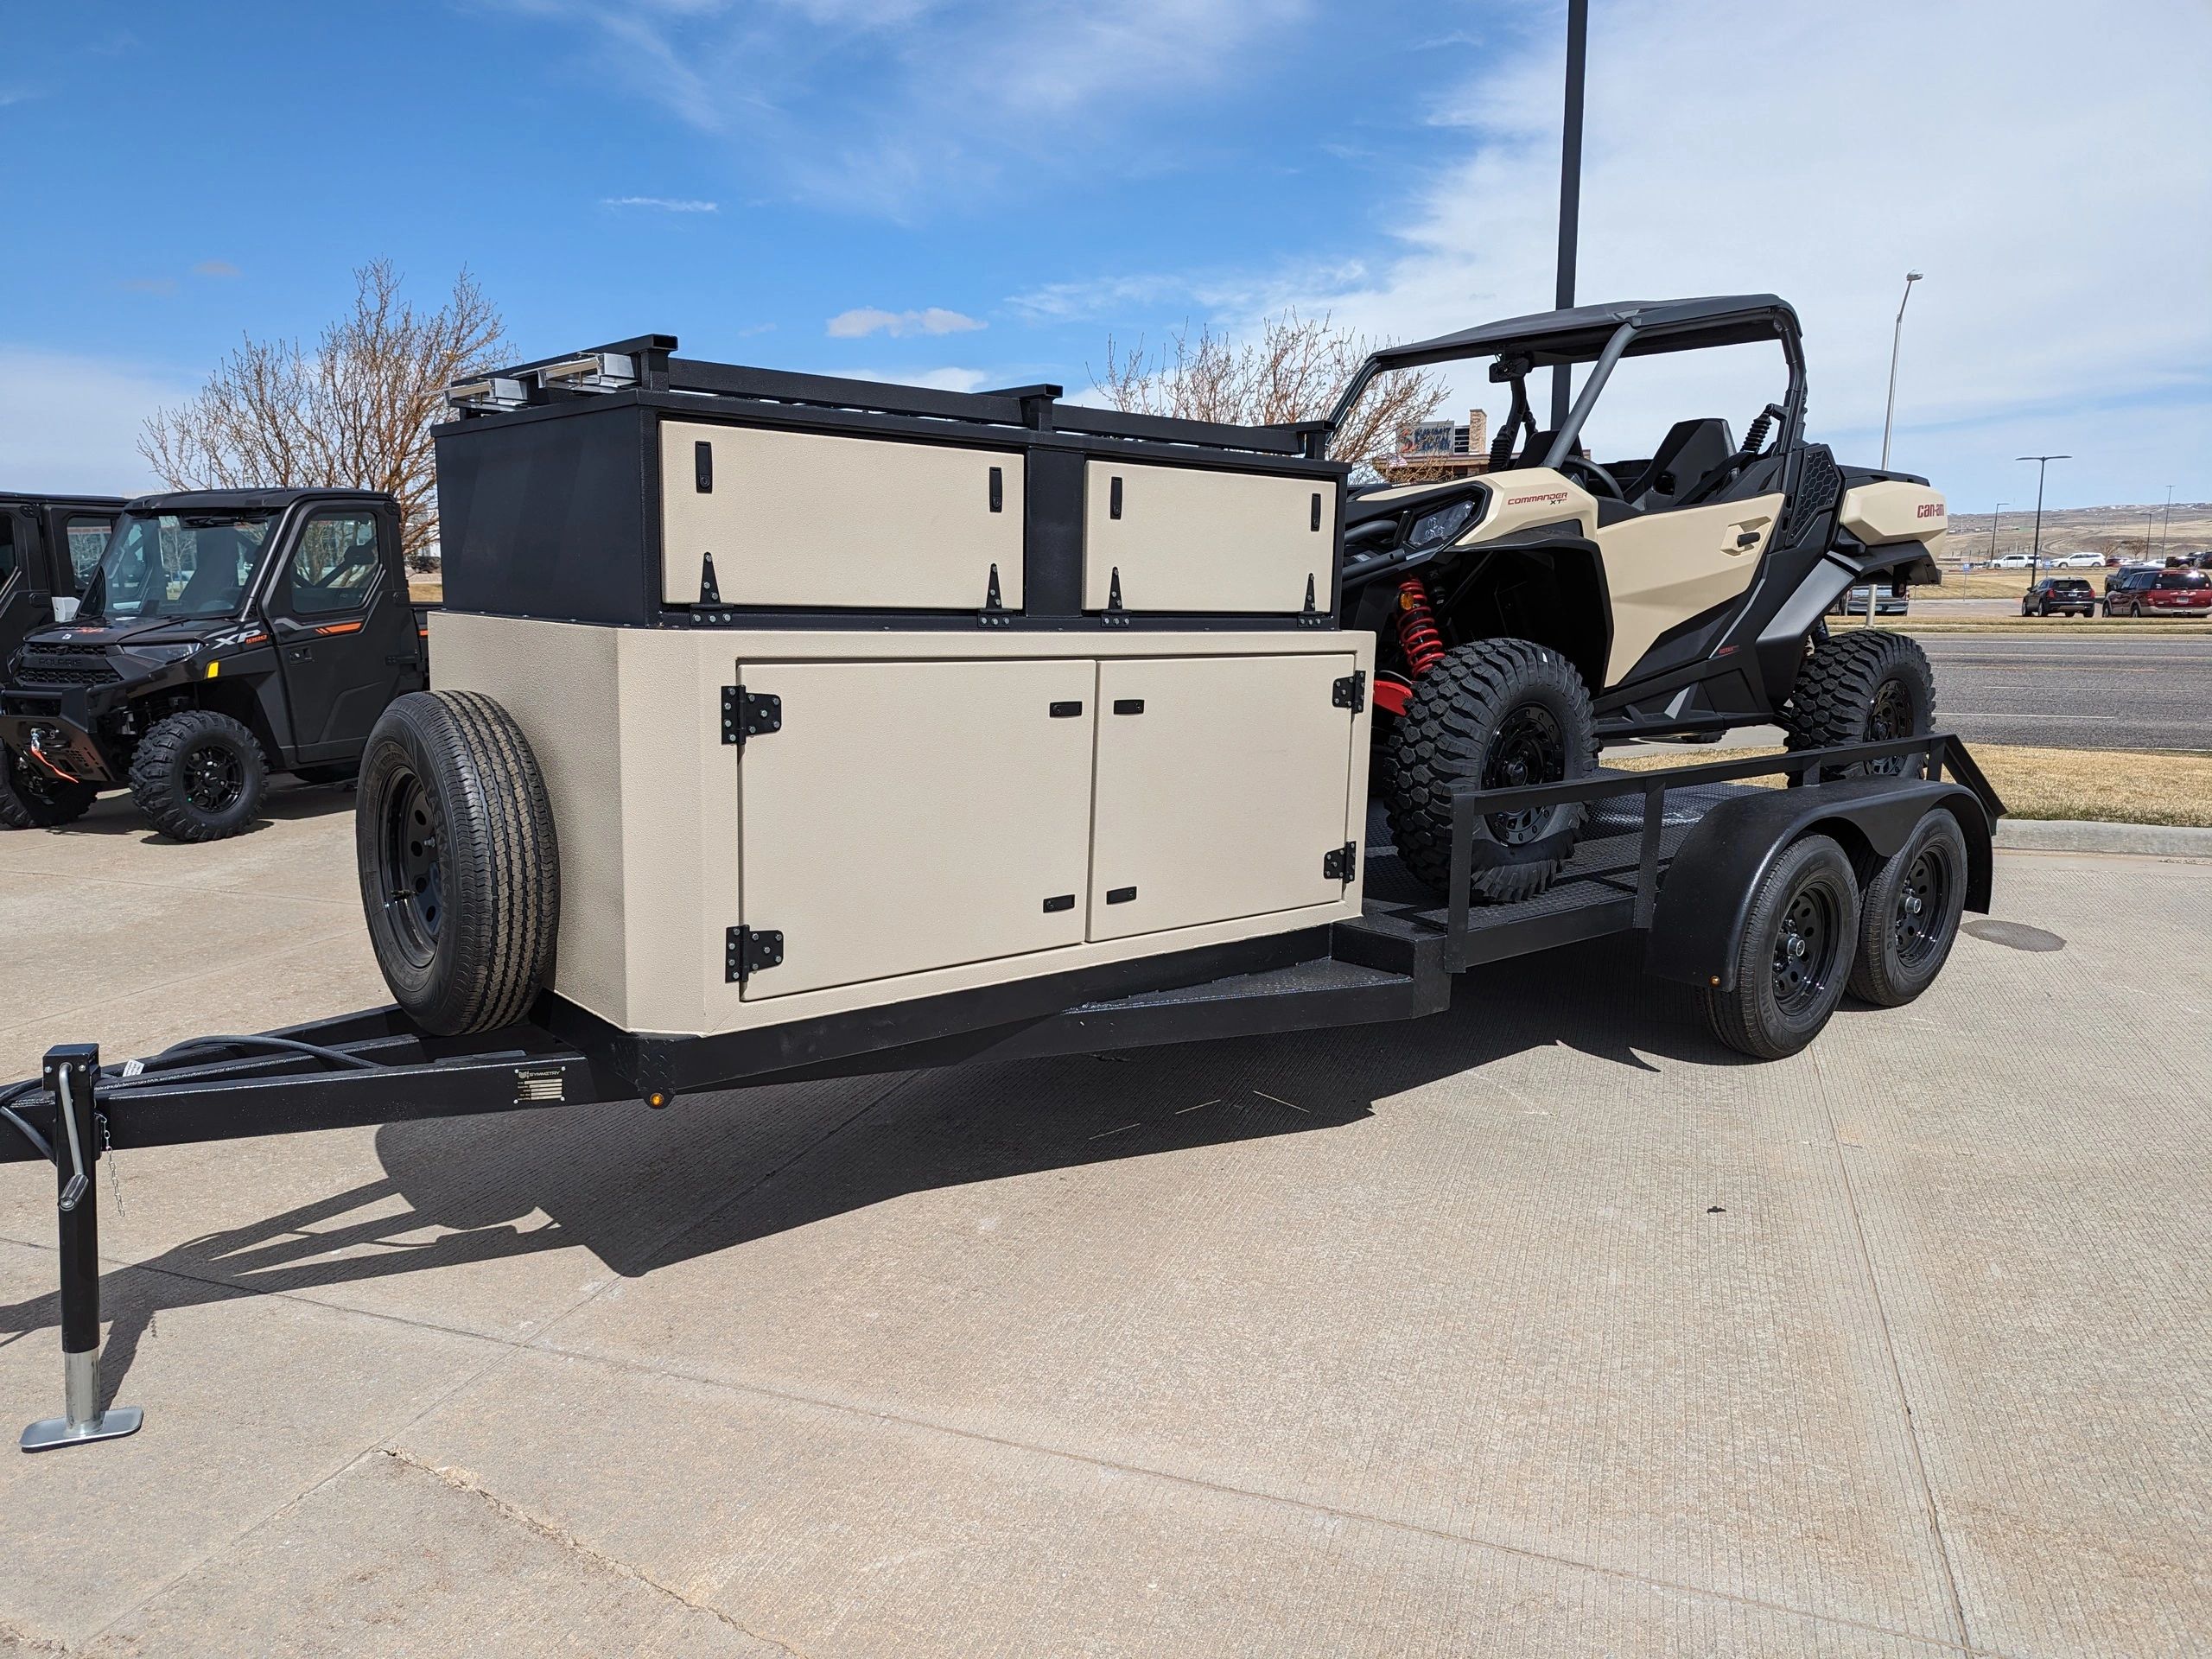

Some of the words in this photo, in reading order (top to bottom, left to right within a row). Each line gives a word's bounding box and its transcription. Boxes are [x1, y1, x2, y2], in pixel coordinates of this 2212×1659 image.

[1507, 492, 1568, 505] COMMANDER
[211, 629, 261, 651] XP
[245, 634, 268, 645] 1000
